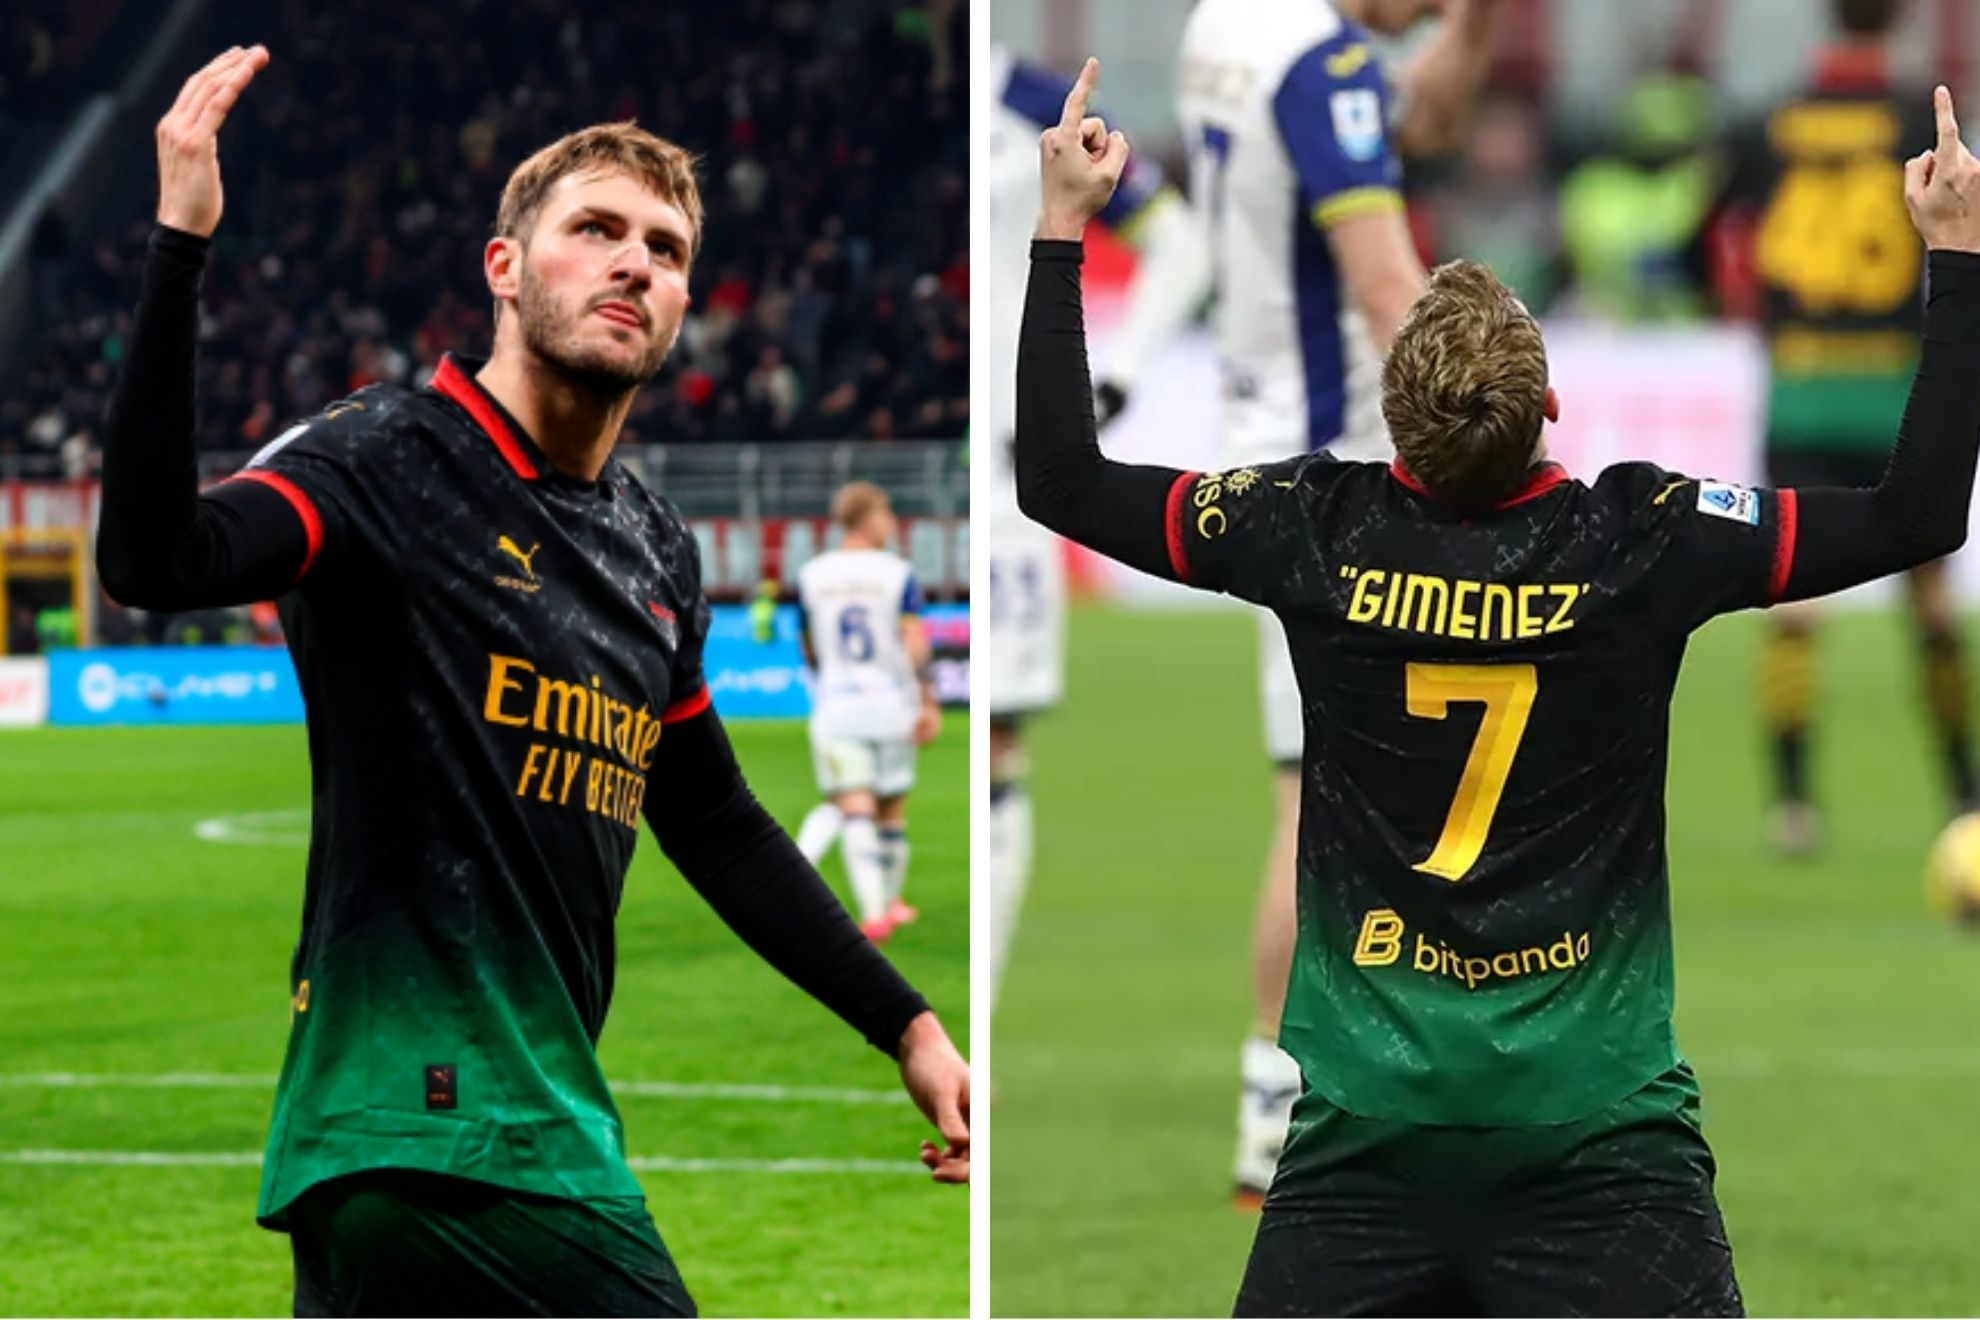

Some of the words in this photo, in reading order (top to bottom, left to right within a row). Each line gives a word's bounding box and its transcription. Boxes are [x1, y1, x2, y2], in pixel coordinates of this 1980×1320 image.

[838, 604, 877, 664] 6
[516, 743, 582, 806] FLY
[1405, 662, 1539, 883] 7
[1413, 930, 1591, 990] bitpanda
